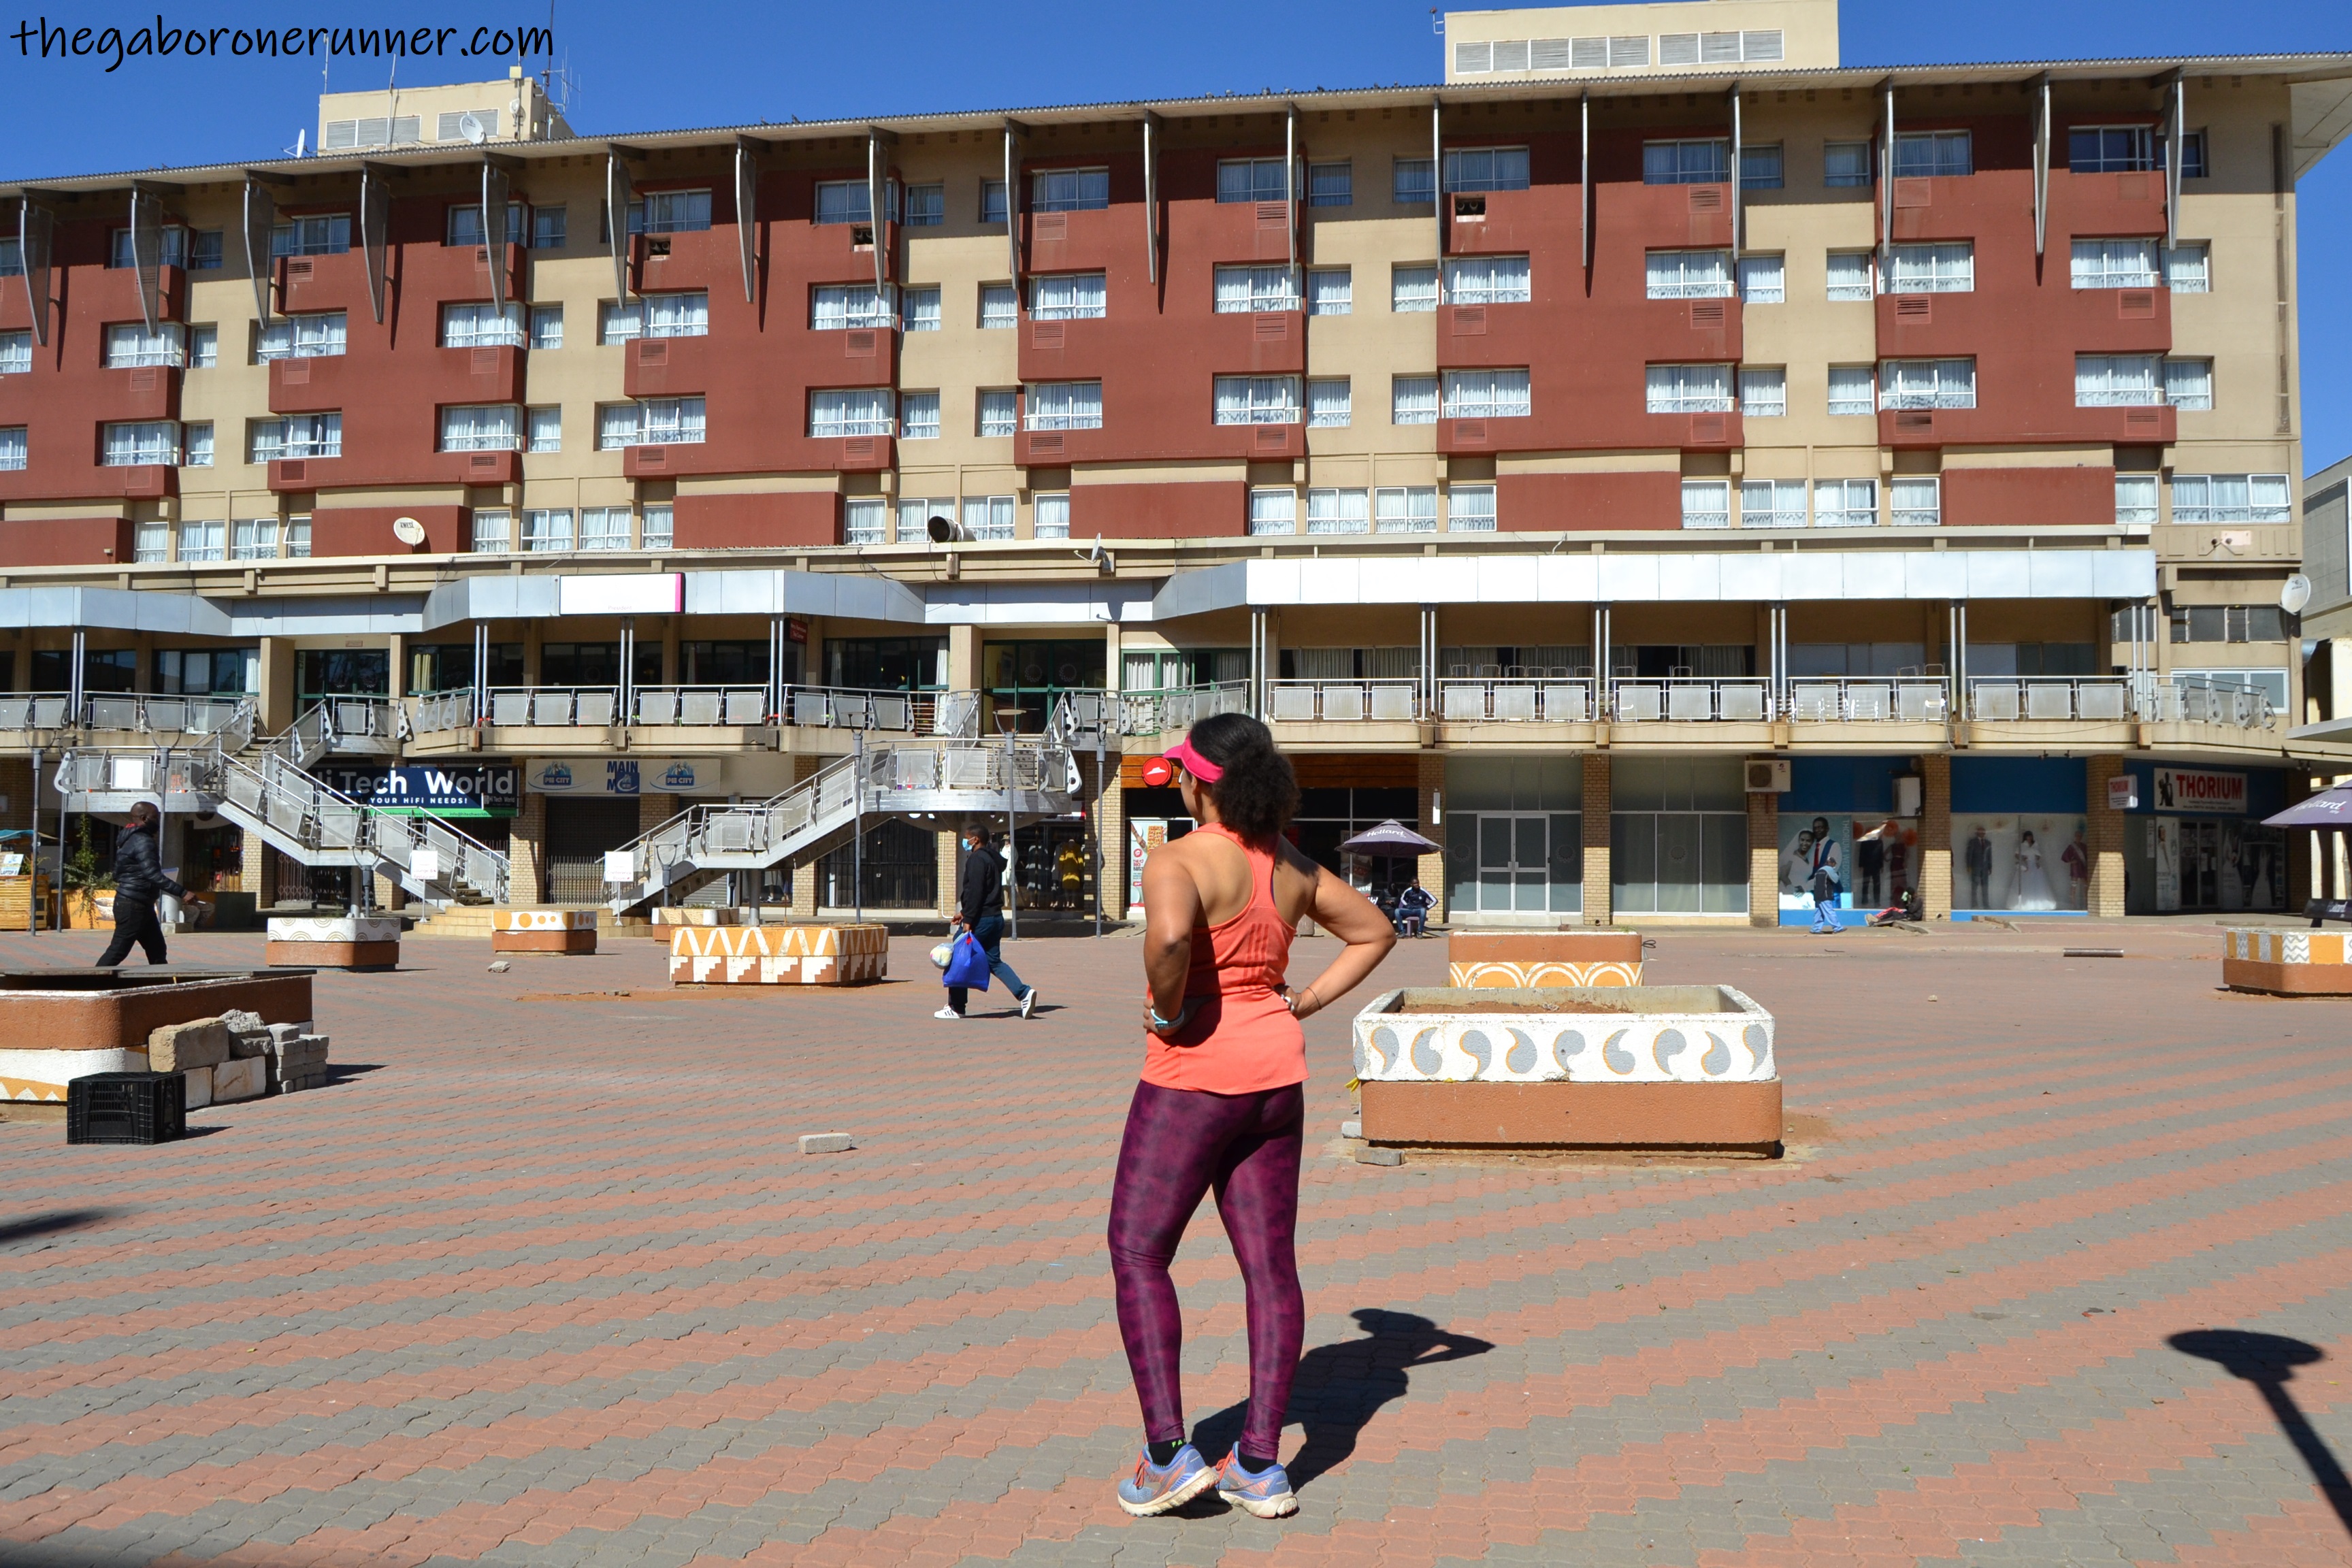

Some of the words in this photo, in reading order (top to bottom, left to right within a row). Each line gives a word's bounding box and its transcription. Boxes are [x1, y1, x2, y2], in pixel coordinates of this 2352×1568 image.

[606, 761, 638, 773] MAIN
[339, 770, 407, 795] Tech
[424, 770, 513, 795] World
[2176, 774, 2242, 800] THORIUM
[1367, 829, 1404, 837] Hollard
[1842, 820, 1850, 853] THORIUM
[1842, 854, 1850, 887] WEDDING
